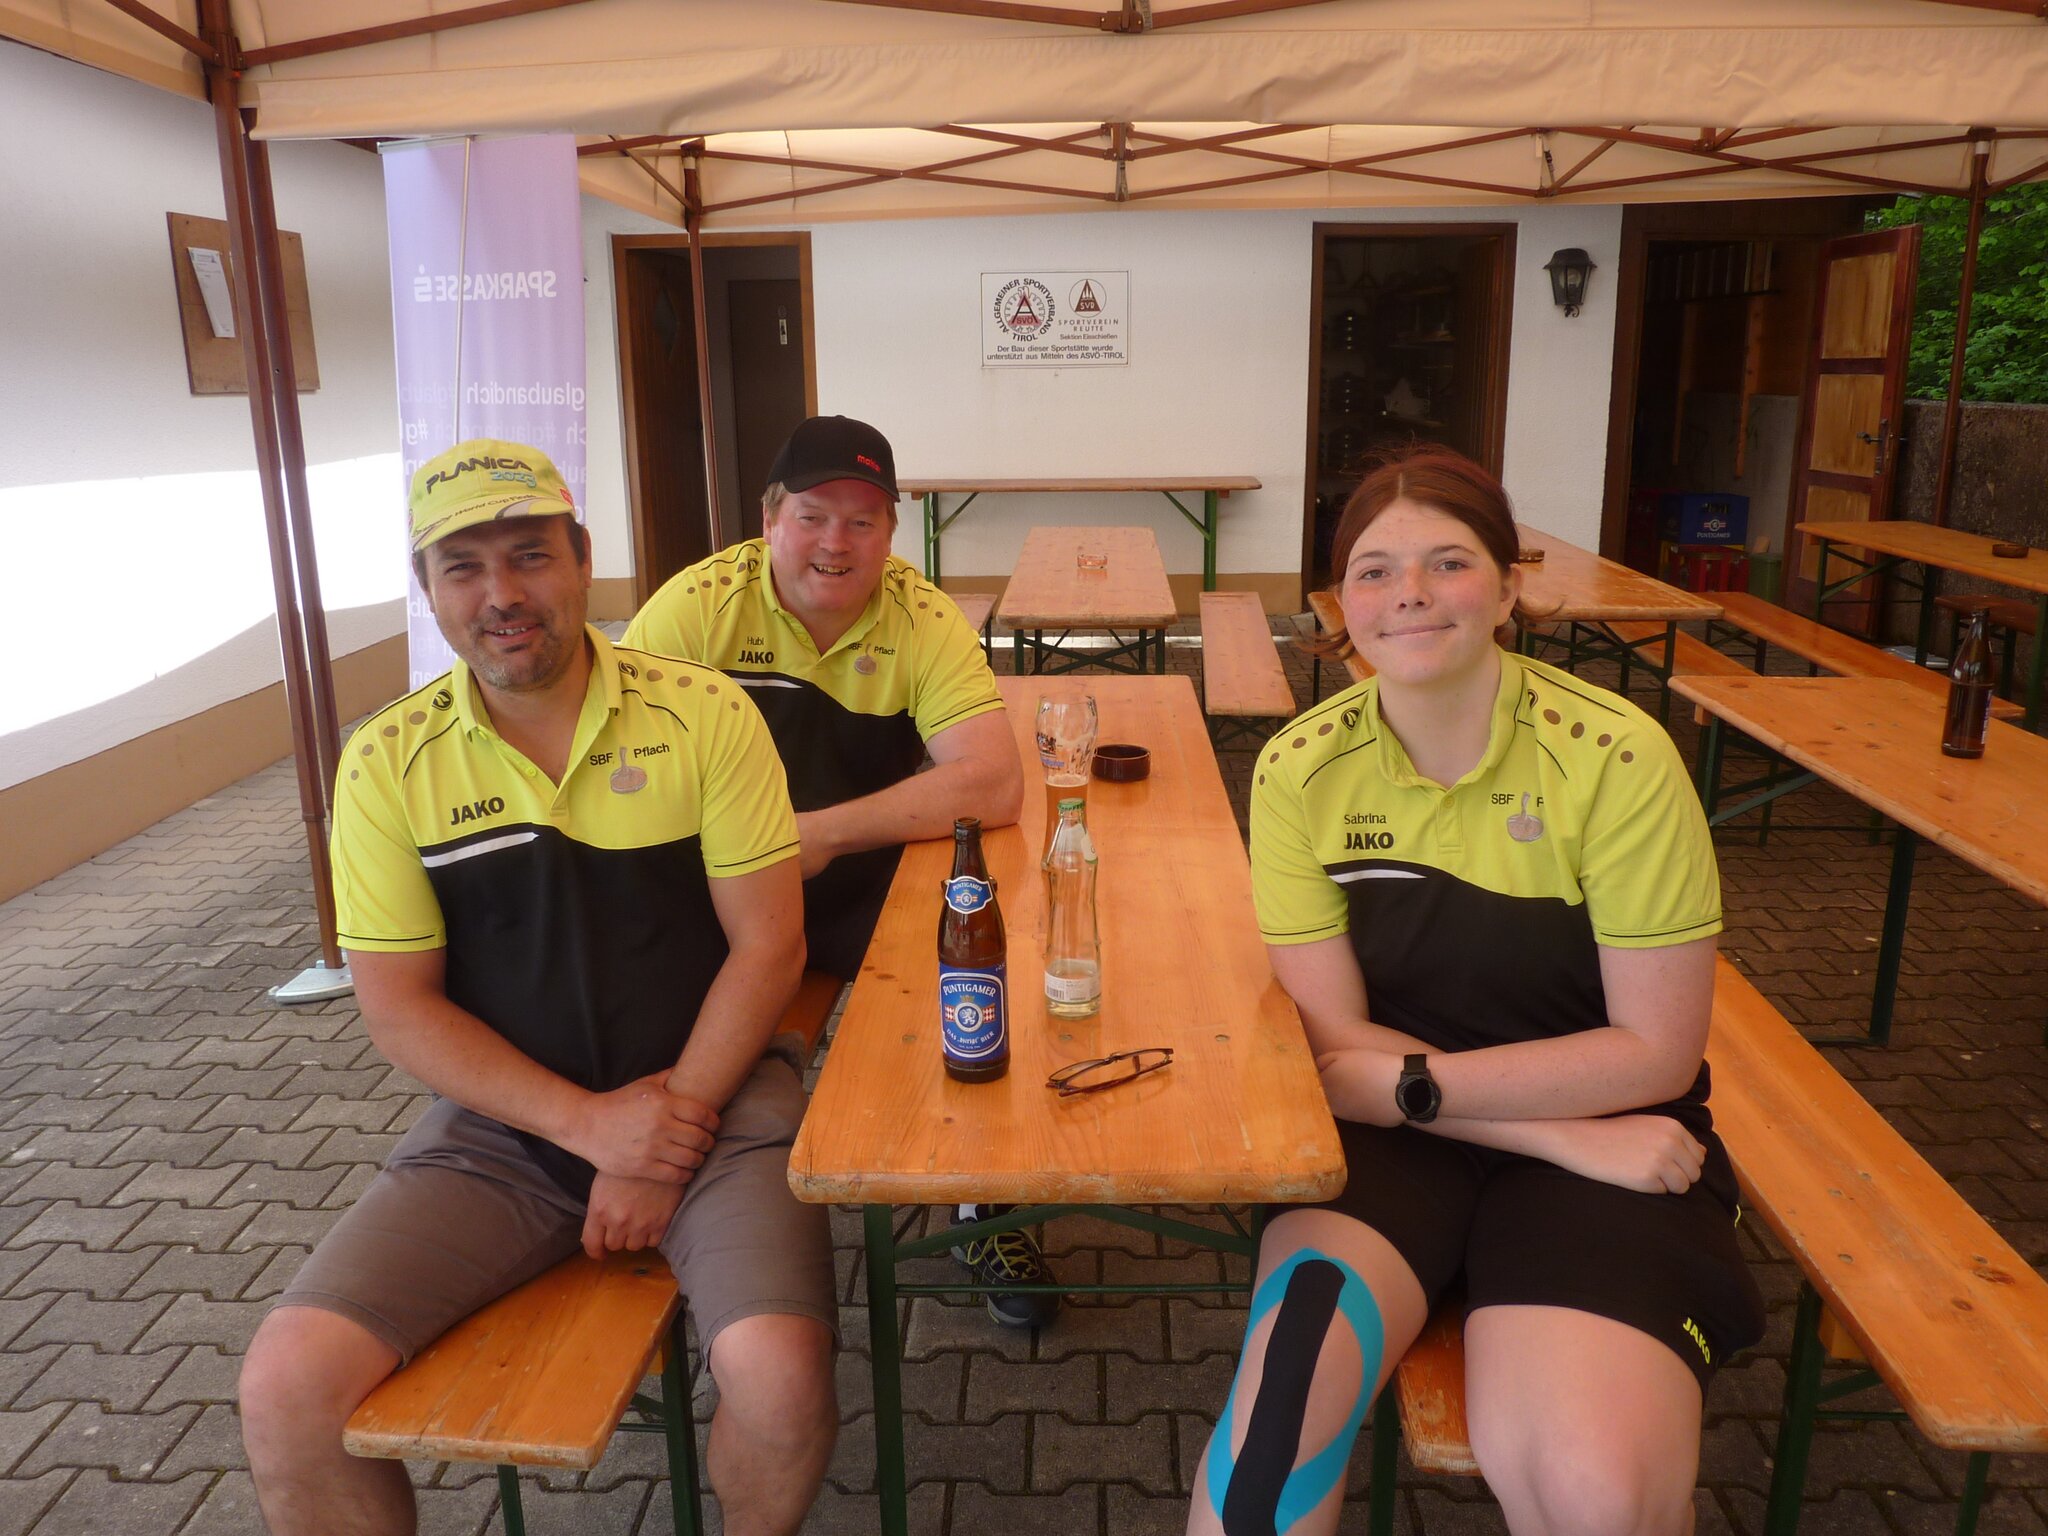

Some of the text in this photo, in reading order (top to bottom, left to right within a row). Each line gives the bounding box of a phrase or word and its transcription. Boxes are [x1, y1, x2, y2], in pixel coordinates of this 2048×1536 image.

[993, 278, 1056, 335] ALLGEMEINER SPORTVERBAND
[1012, 332, 1038, 342] TIROL
[986, 352, 1023, 360] unterstützt
[1080, 351, 1125, 359] ASVÖ-TIROL
[997, 345, 1009, 353] Der
[1051, 344, 1090, 353] Sportstätte
[1091, 344, 1114, 352] wurde
[426, 455, 533, 495] PLANICA
[489, 470, 537, 488] 2023
[738, 650, 775, 664] JAKO
[590, 742, 671, 766] SBF Pflach
[1490, 793, 1516, 805] SBF
[450, 796, 506, 826] JAKO
[1343, 812, 1388, 825] Sabrina
[1343, 831, 1395, 850] JAKO
[942, 983, 997, 998] PUNTIGAMER
